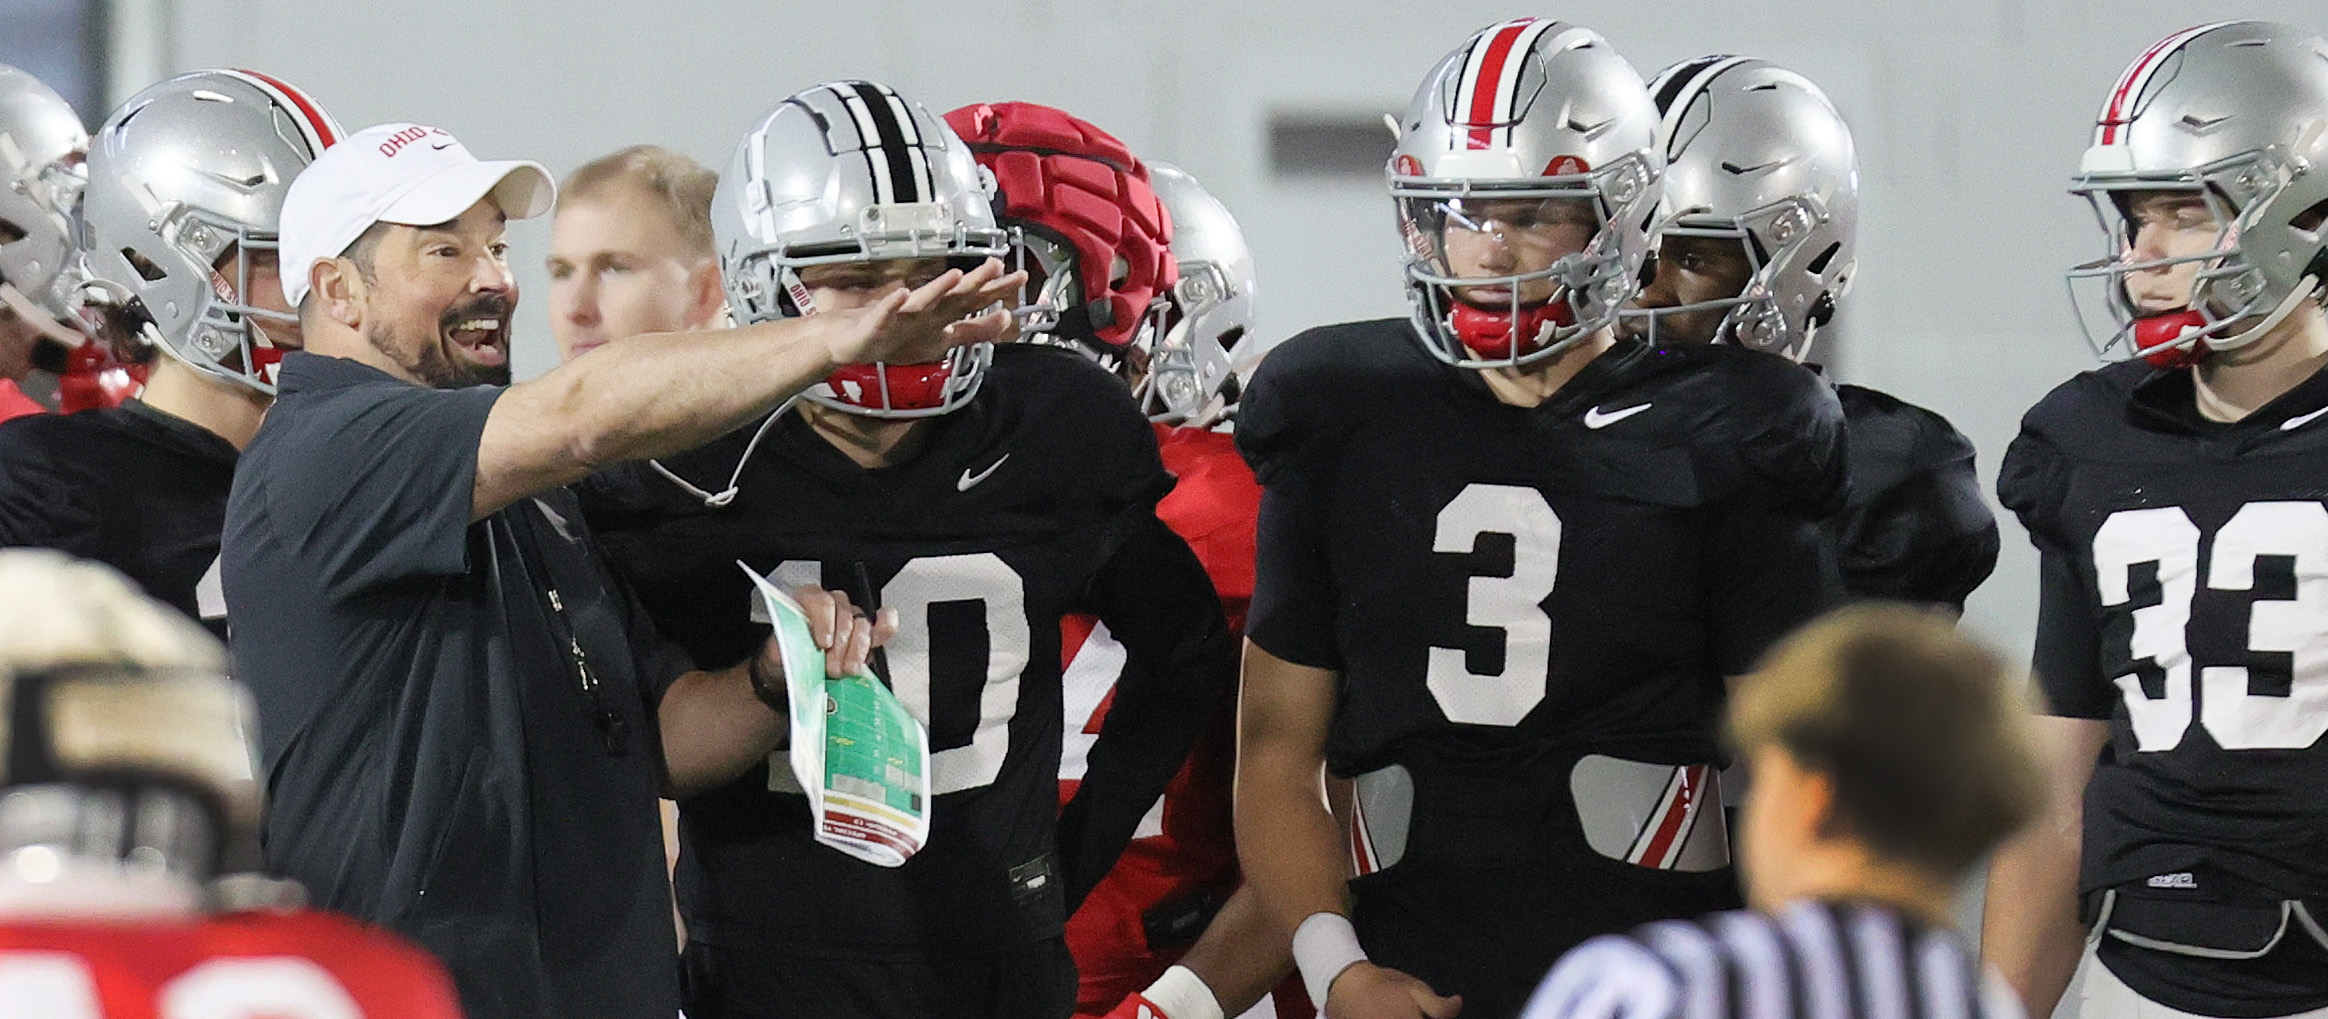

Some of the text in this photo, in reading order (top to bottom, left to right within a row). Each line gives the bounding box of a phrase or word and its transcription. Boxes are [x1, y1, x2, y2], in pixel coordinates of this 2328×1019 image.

[379, 126, 427, 158] OHIO
[790, 284, 811, 307] OHIO
[1426, 483, 1562, 727] 3
[2092, 500, 2328, 752] 33
